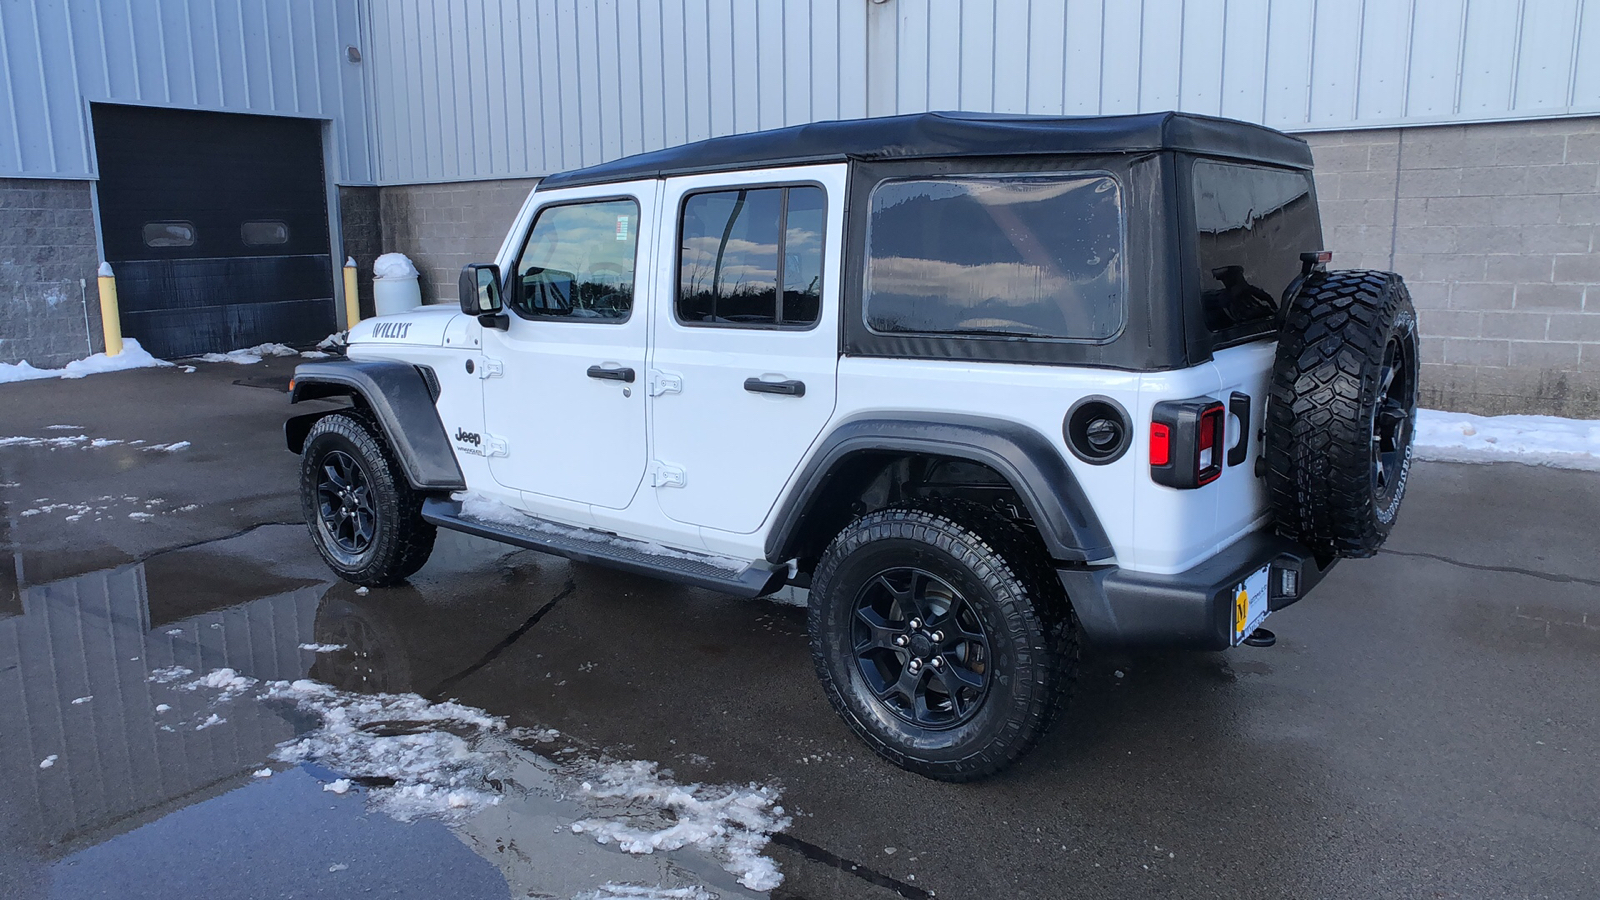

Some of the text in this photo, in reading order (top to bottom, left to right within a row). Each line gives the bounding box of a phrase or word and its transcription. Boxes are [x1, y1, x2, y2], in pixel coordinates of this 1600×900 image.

[372, 322, 412, 338] WILLYS
[455, 426, 481, 447] Jeep
[1236, 598, 1247, 624] M
